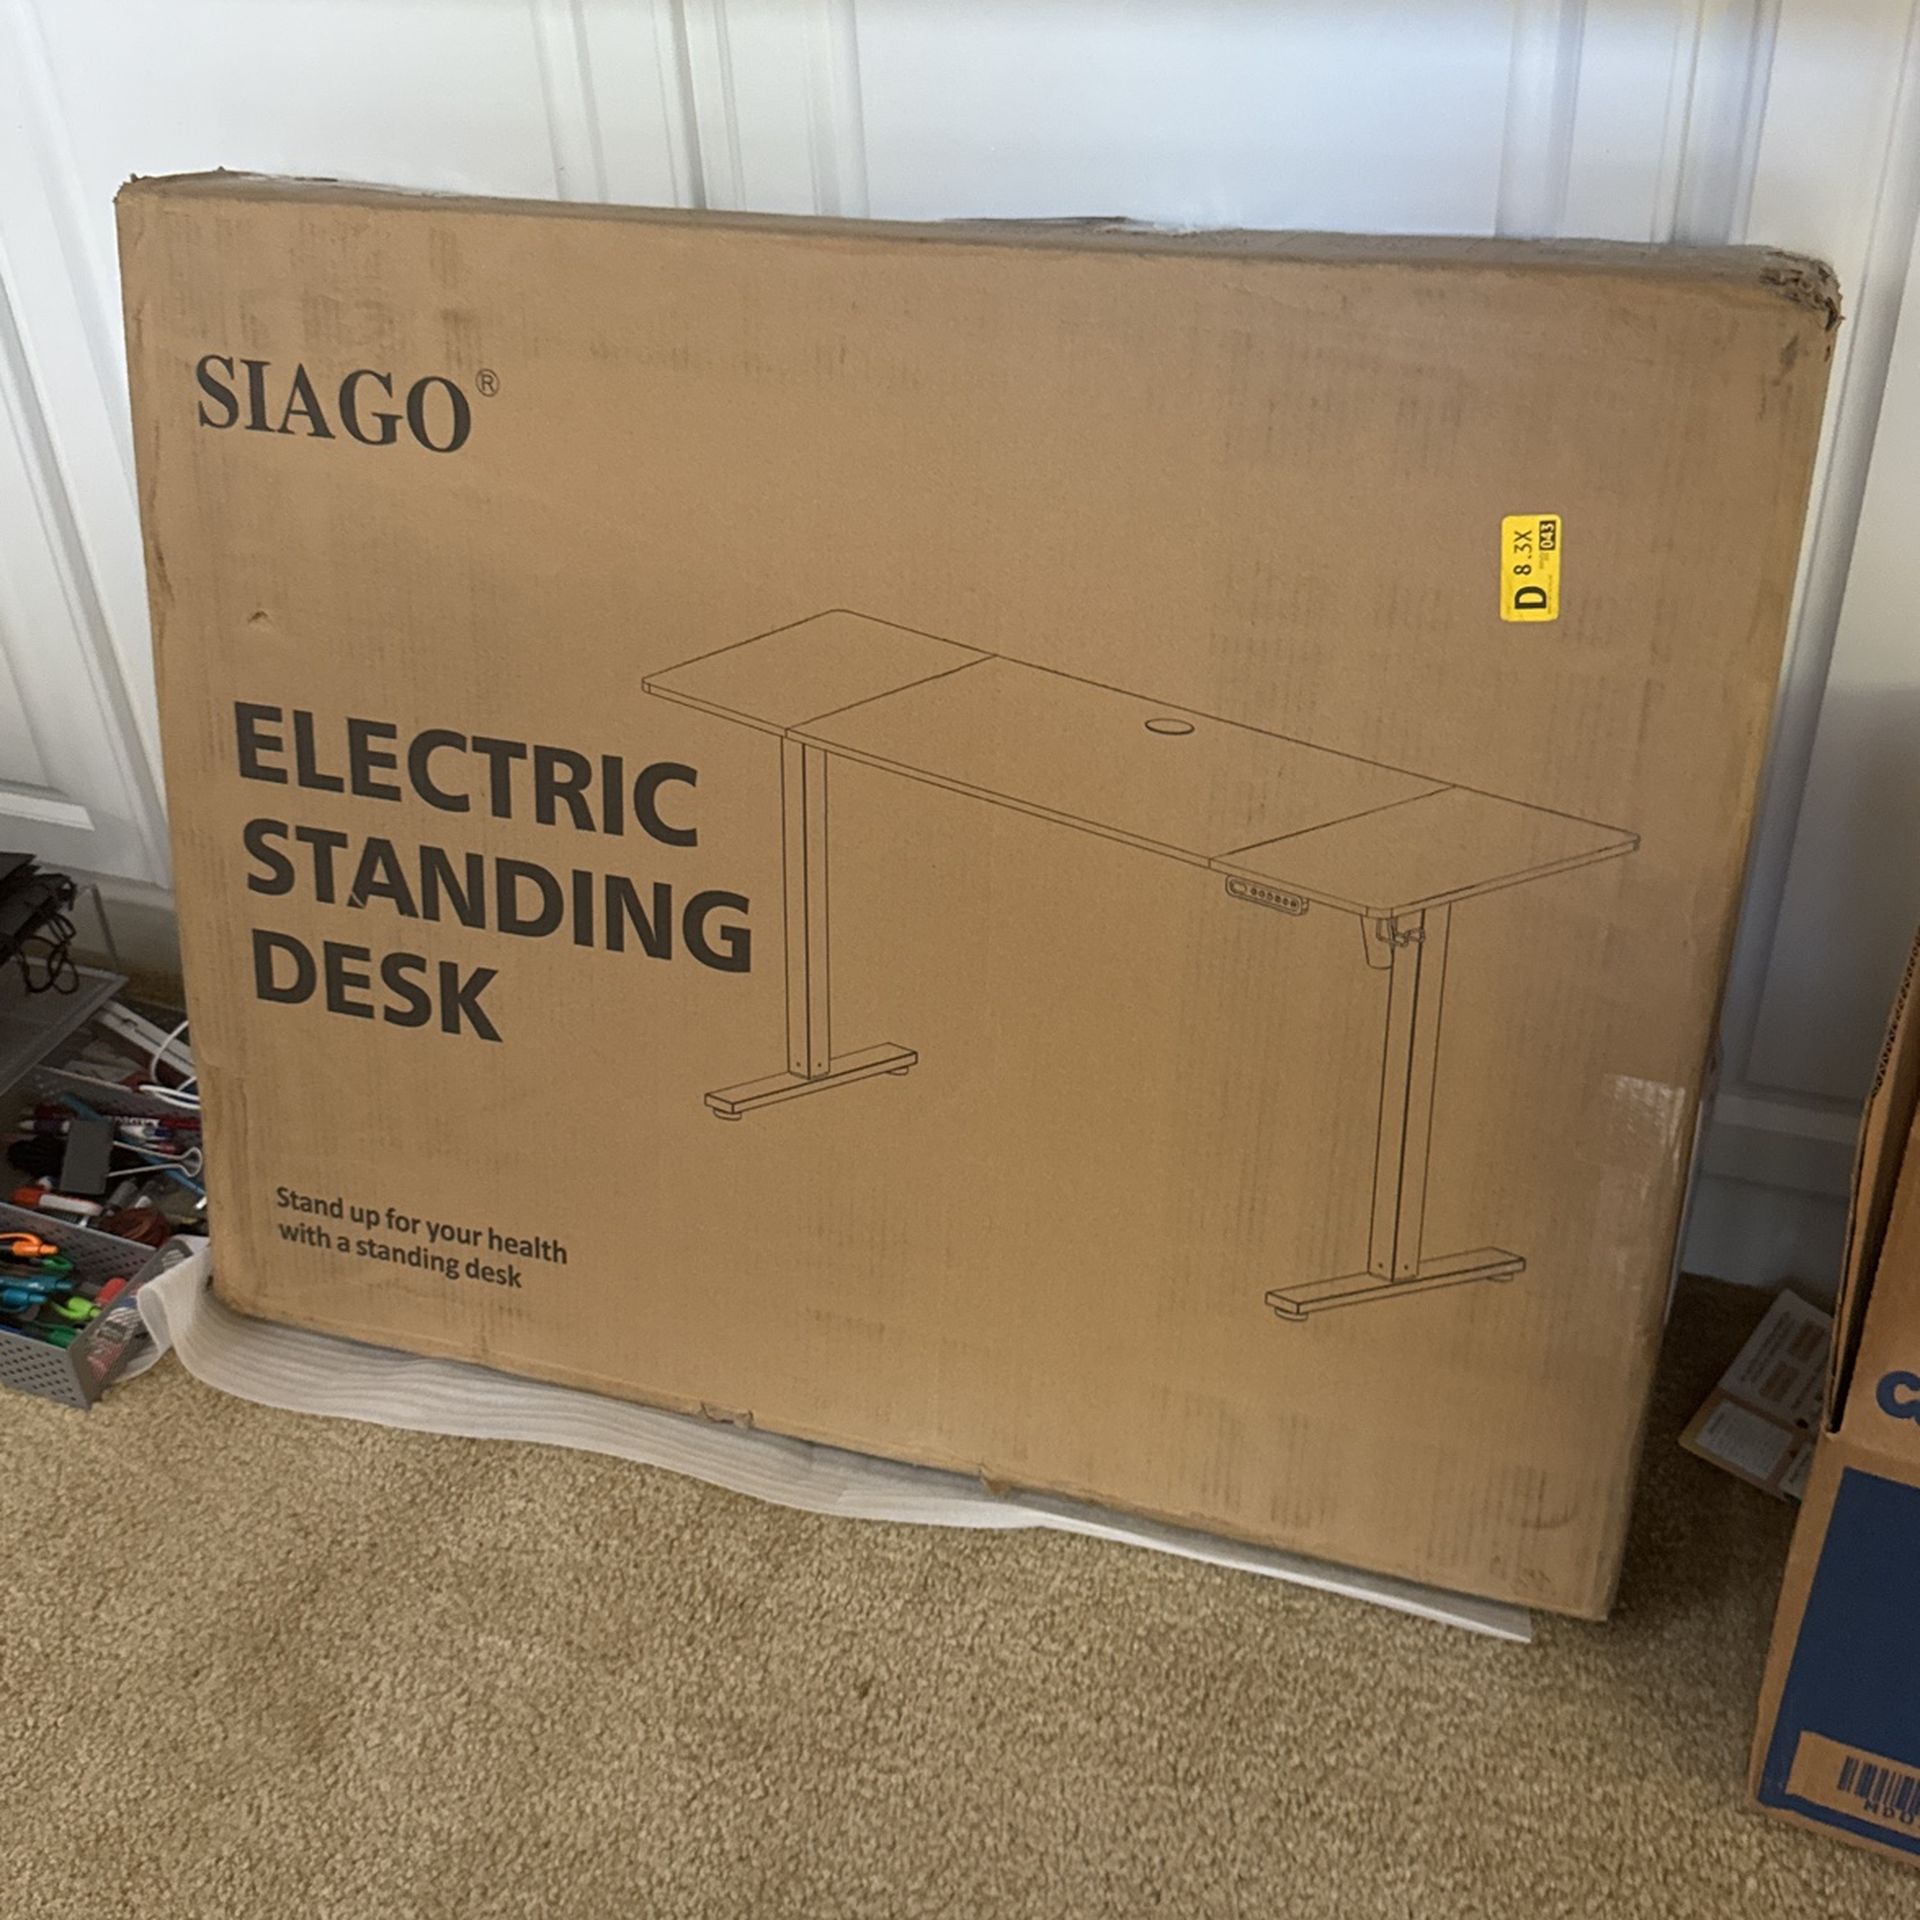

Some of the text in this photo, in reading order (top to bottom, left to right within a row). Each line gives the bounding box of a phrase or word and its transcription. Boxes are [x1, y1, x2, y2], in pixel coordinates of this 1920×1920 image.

[1540, 522, 1555, 549] 043
[1514, 585, 1547, 610] D
[234, 700, 699, 847] ELECTRIC
[242, 818, 752, 973] STANDING
[251, 928, 504, 1043] DESK
[276, 1186, 568, 1264] Stand up for your health
[279, 1222, 522, 1288] with a standing desk
